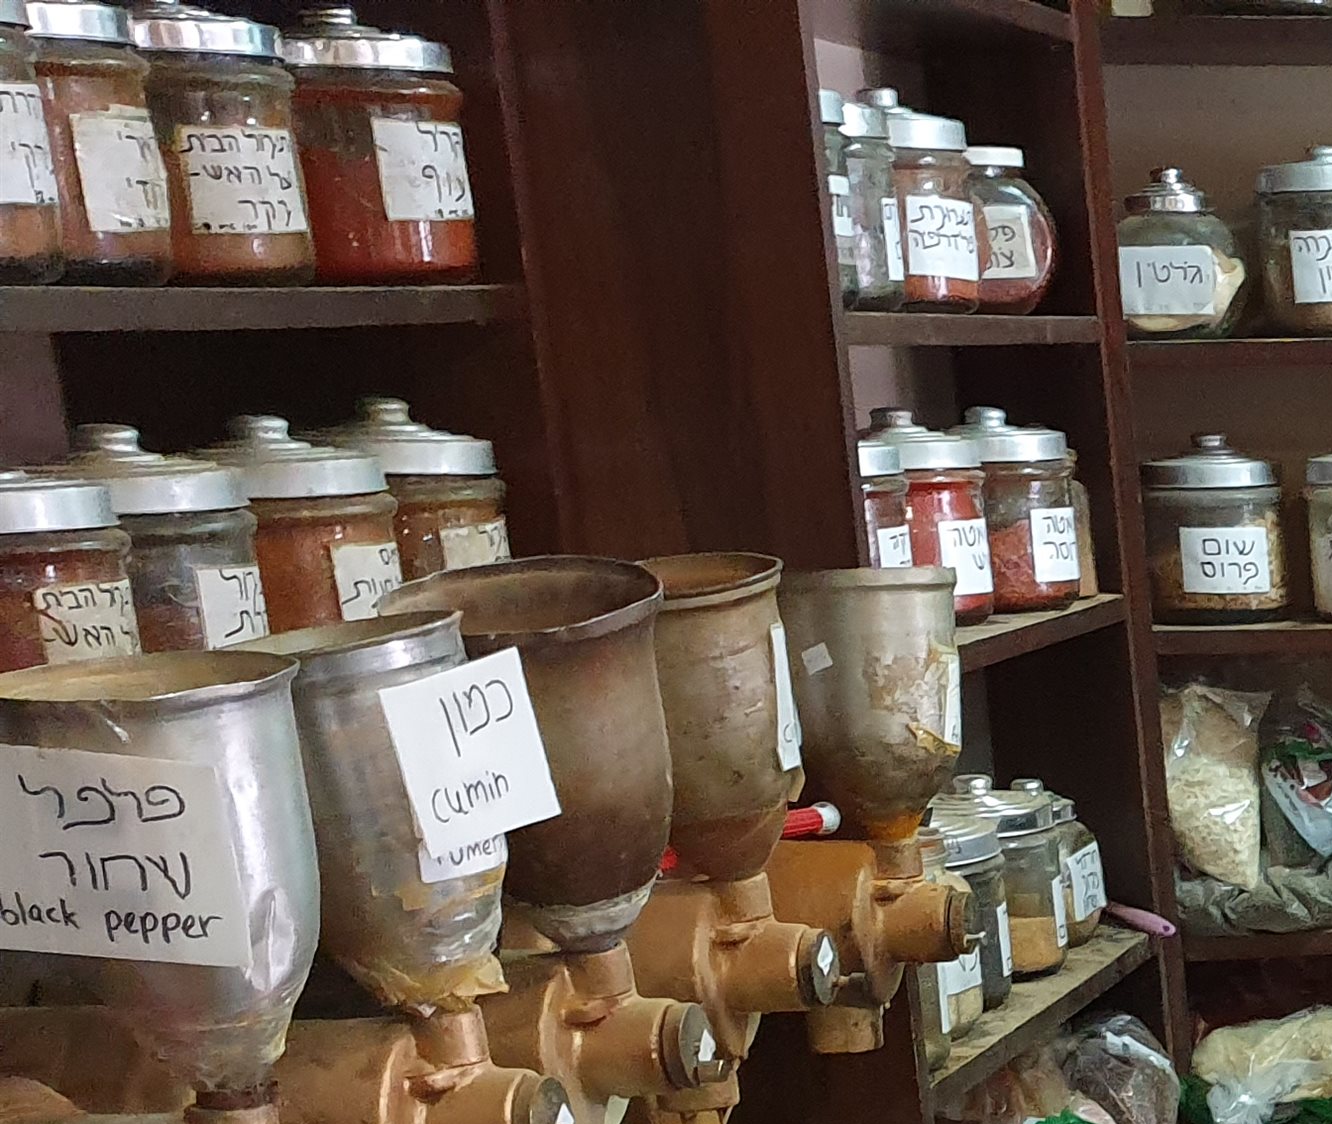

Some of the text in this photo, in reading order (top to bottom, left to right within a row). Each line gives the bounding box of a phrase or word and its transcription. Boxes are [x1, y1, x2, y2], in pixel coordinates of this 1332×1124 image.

[1202, 538, 1255, 556] שום
[1200, 562, 1259, 585] פרוס
[439, 679, 514, 758] כמון
[18, 774, 186, 830] פלפל
[40, 850, 192, 900] שחור
[104, 909, 223, 944] pepper
